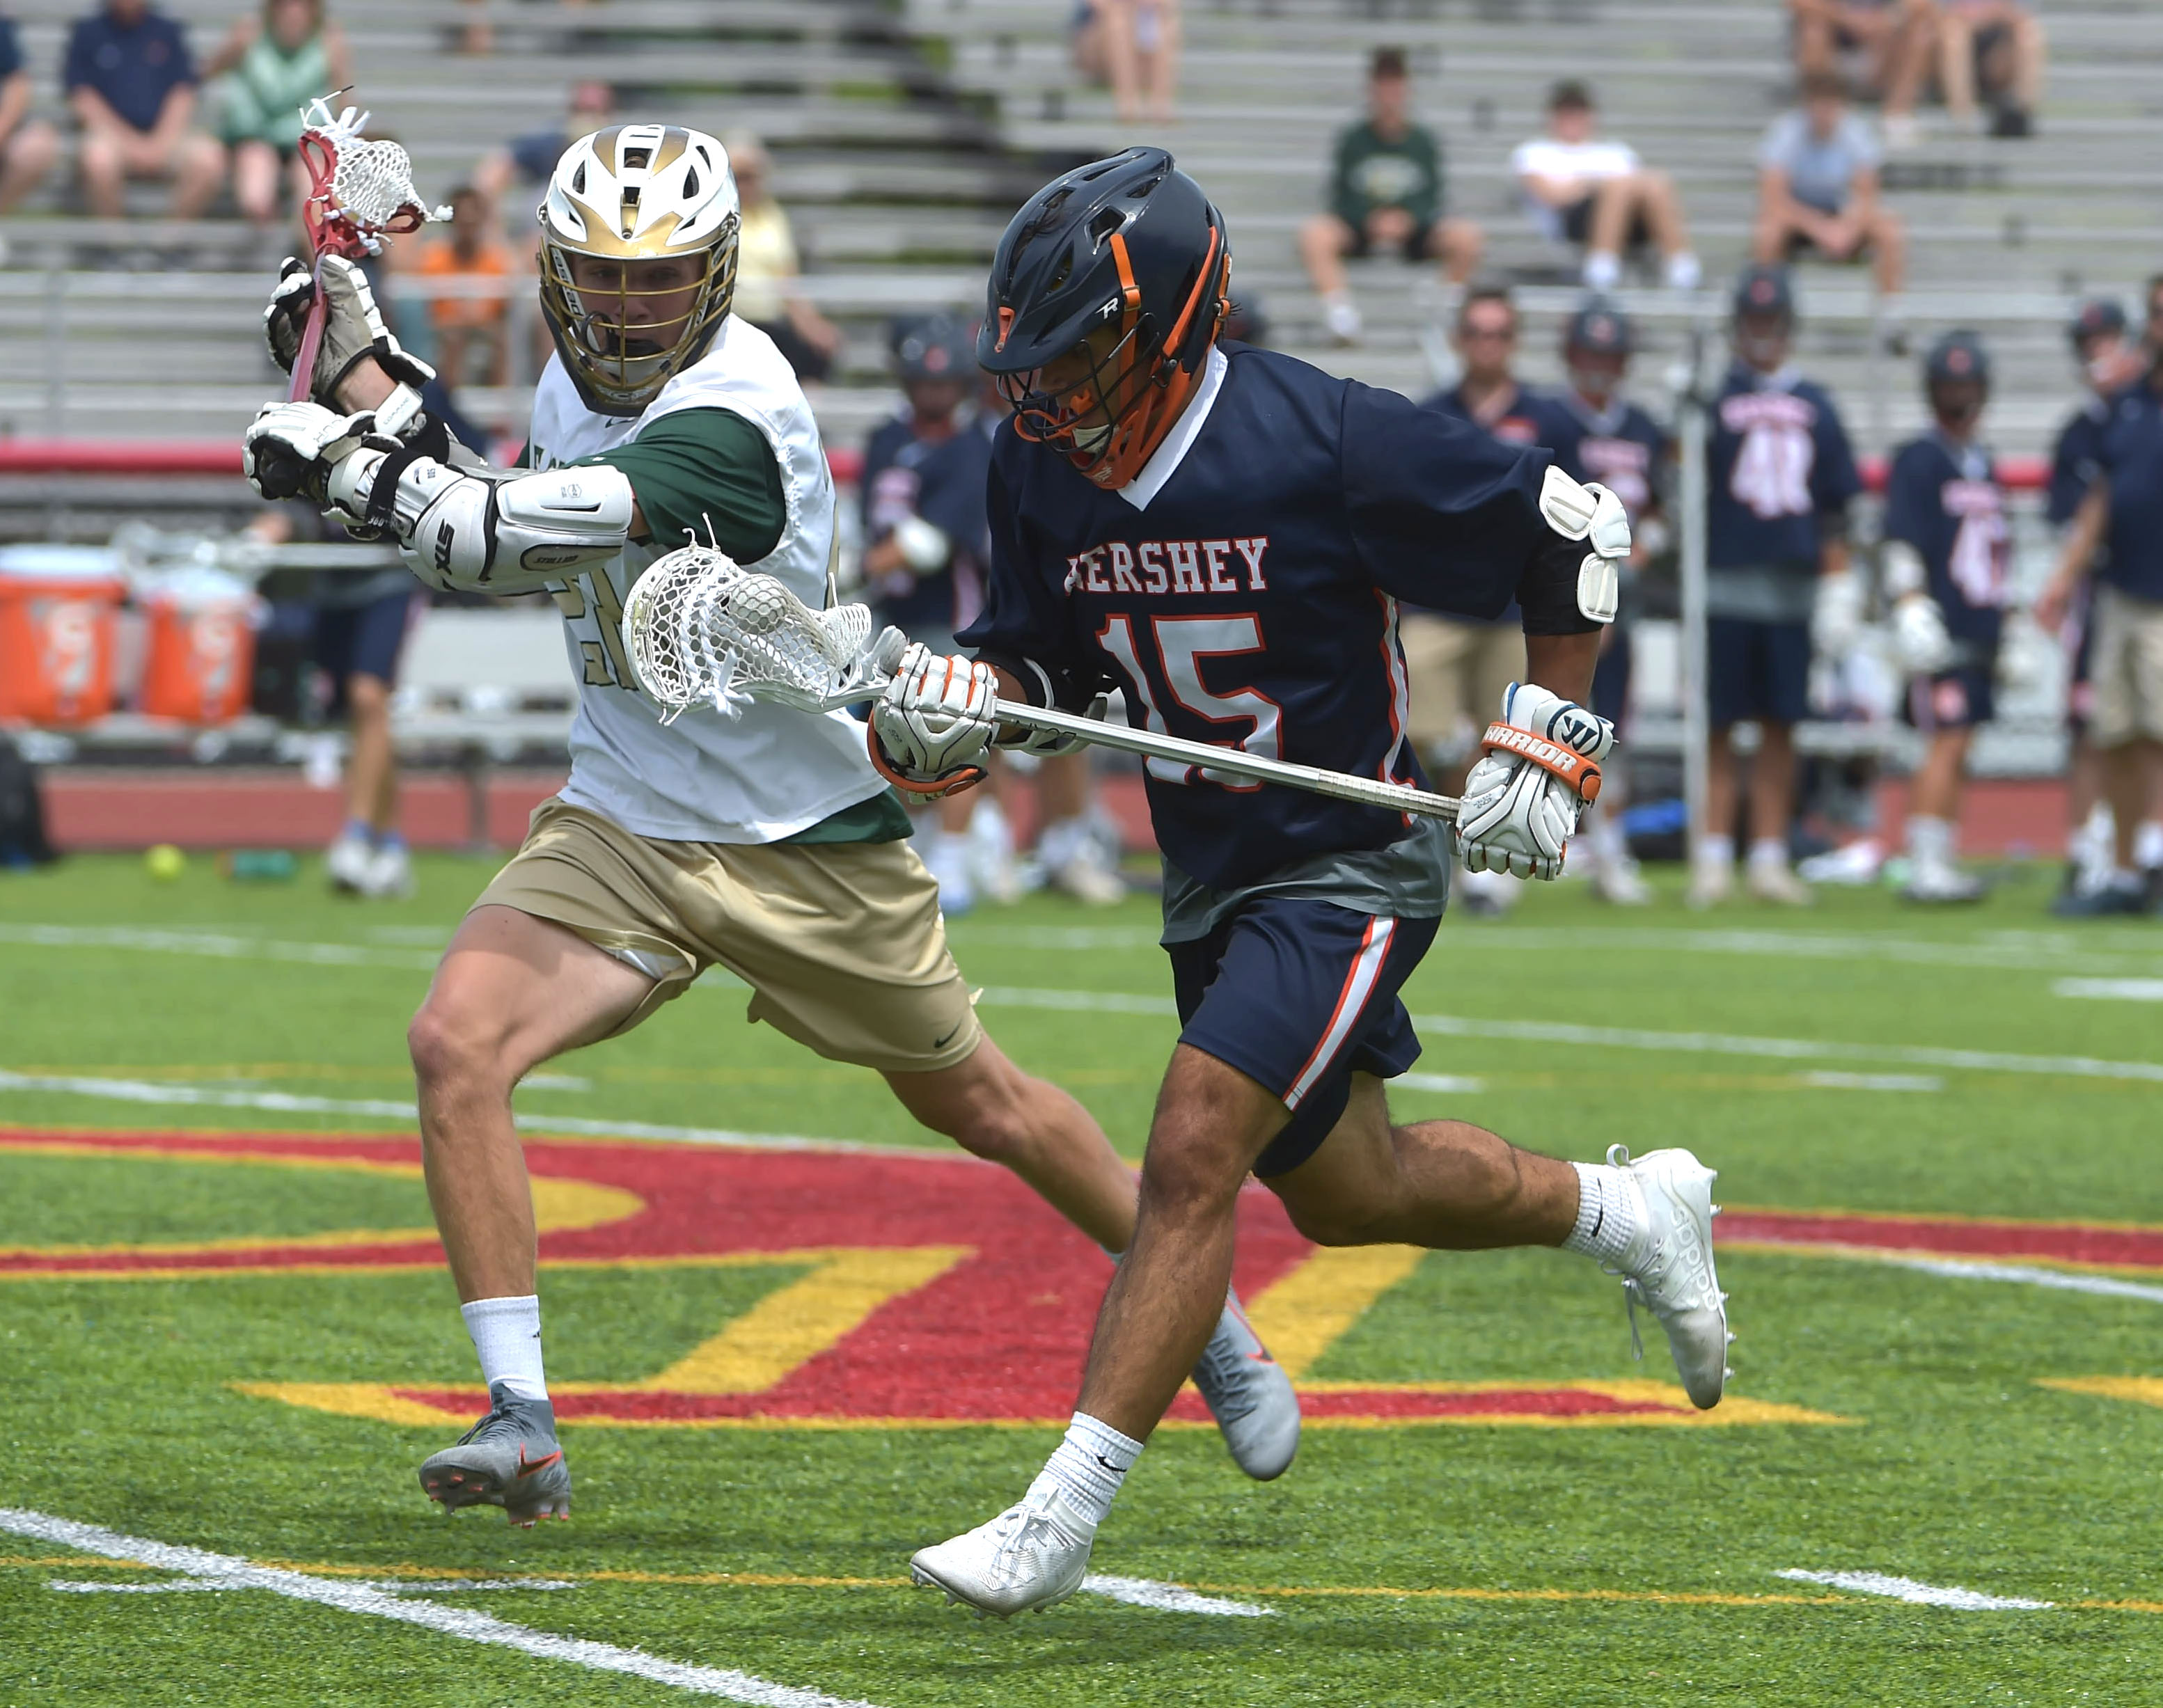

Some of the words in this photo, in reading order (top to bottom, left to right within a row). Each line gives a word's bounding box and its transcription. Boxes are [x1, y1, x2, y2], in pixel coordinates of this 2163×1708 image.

[434, 518, 455, 575] STX
[1094, 611, 1284, 793] 15
[1484, 725, 1578, 773] ARRIOR
[1669, 1205, 1718, 1311] adidas
